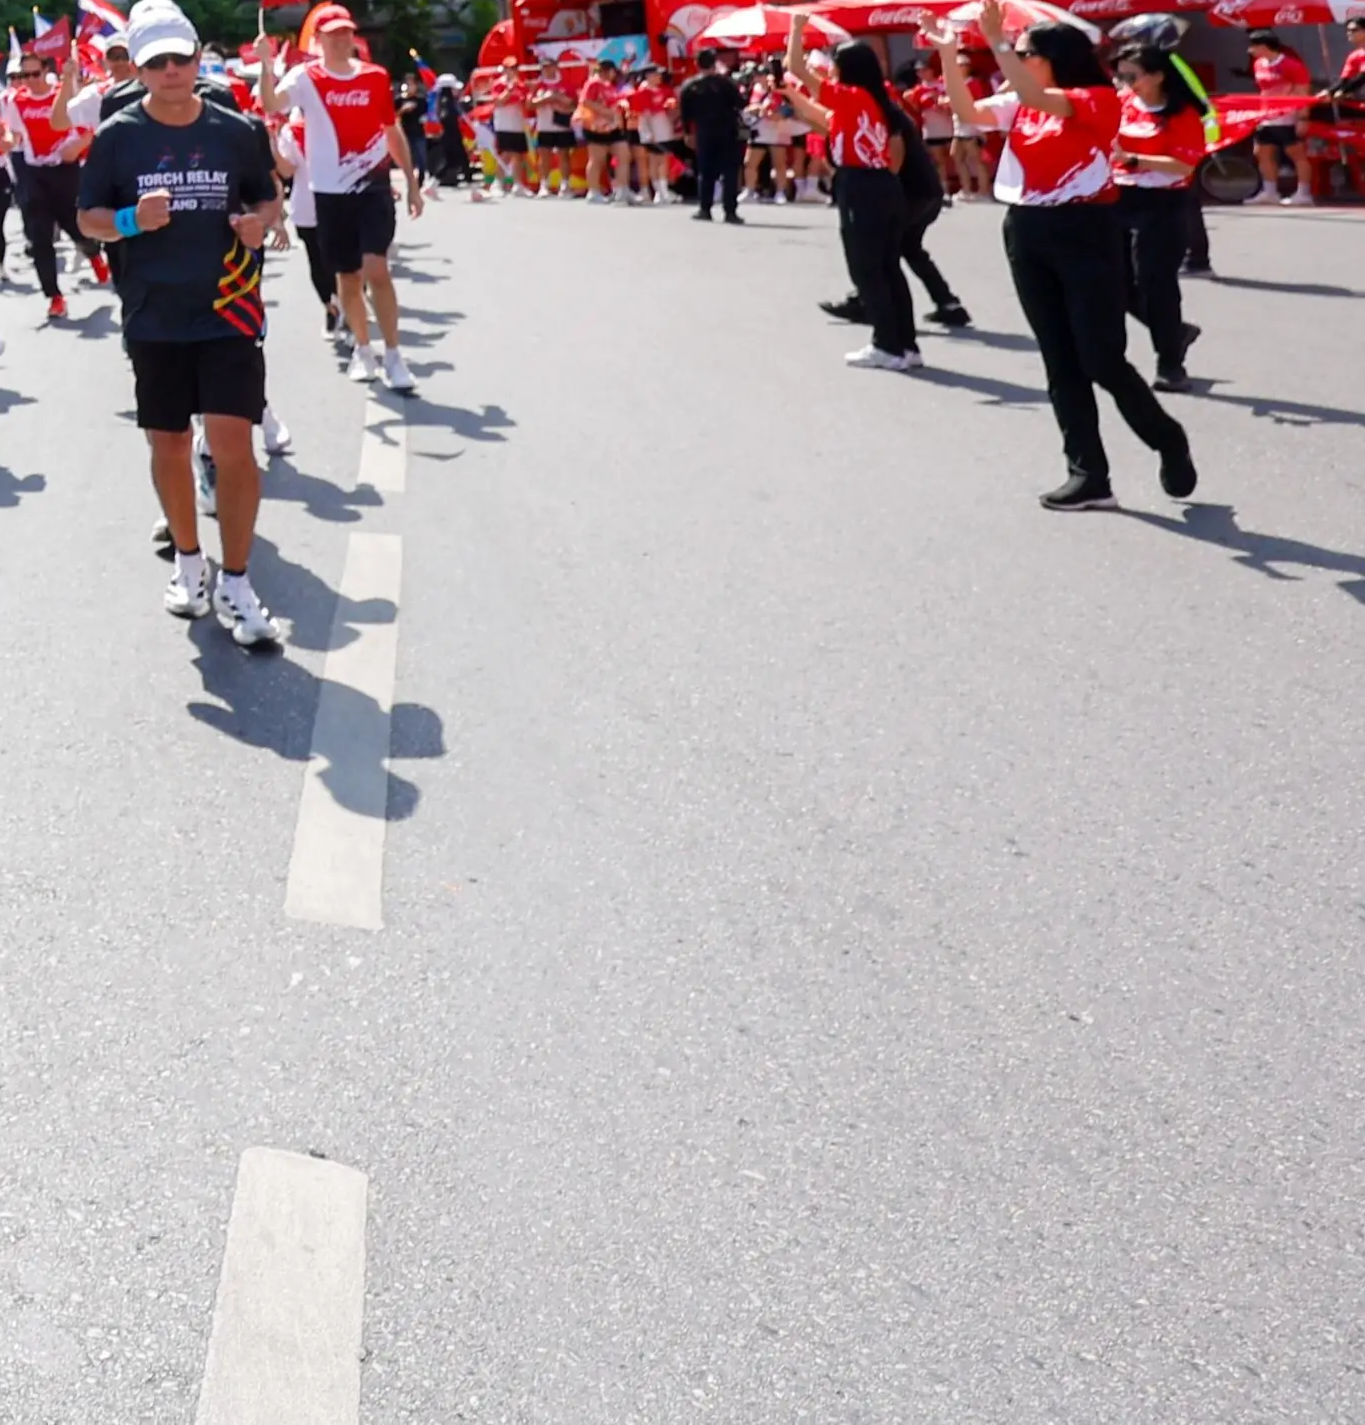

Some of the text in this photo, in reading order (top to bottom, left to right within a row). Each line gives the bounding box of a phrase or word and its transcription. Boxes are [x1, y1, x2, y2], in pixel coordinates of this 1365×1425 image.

[137, 169, 228, 188] TORCH RELAY
[167, 199, 197, 211] LAND
